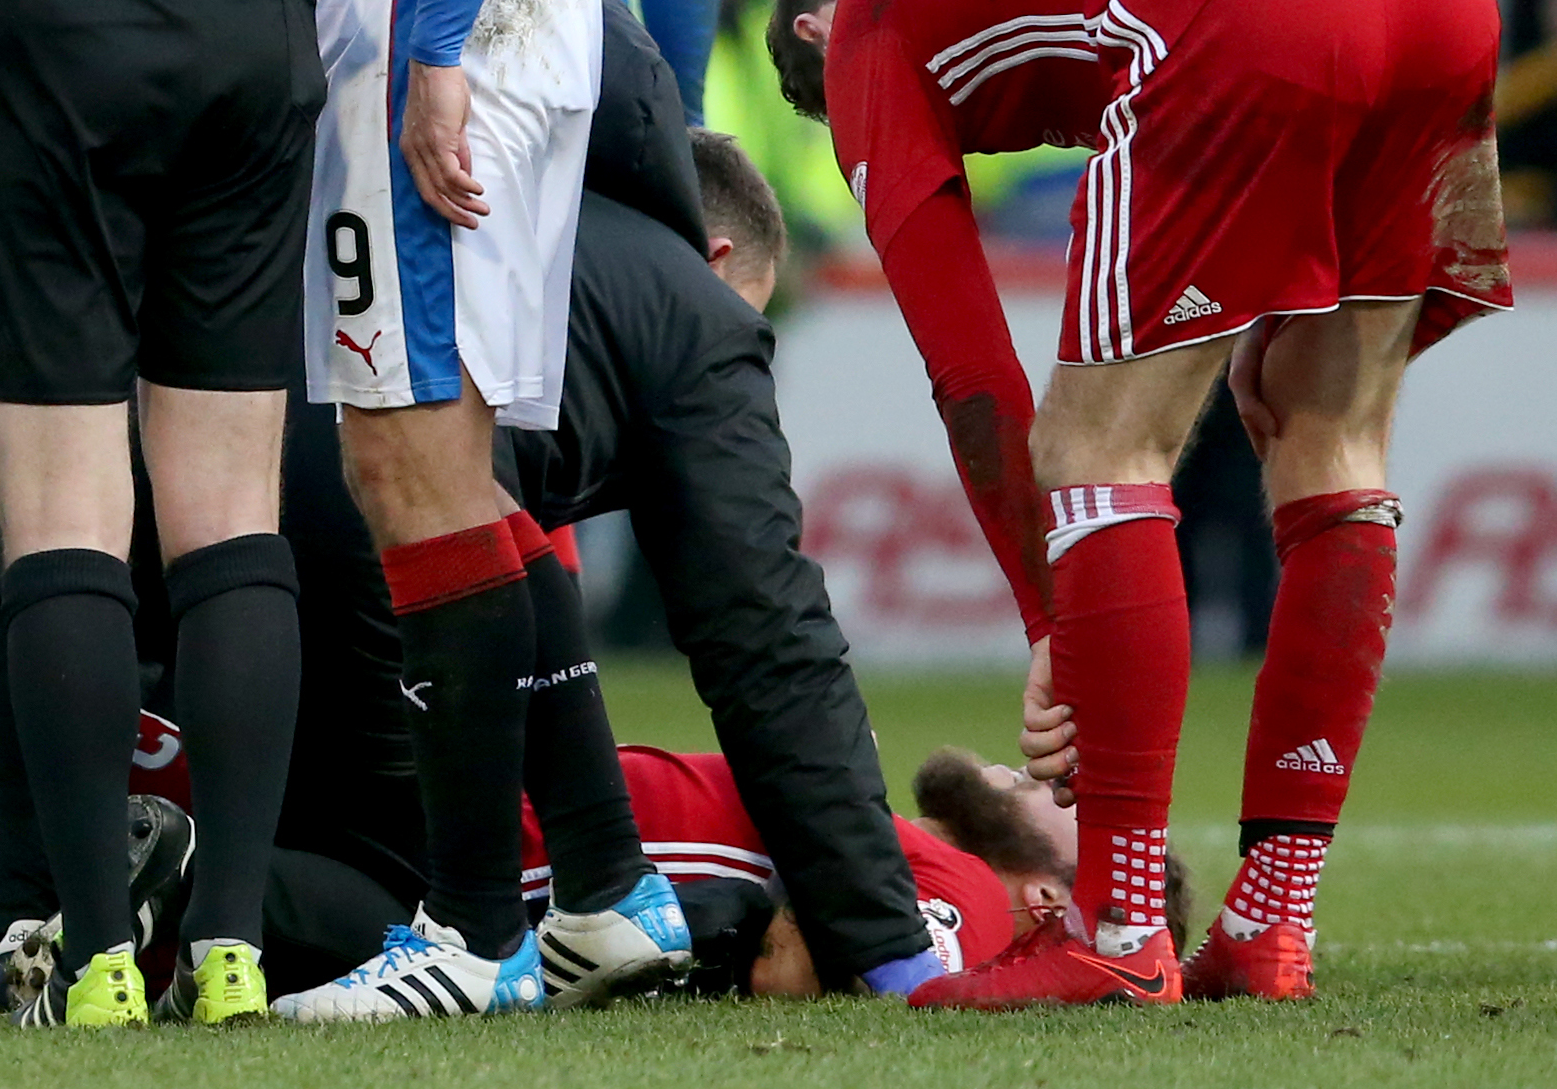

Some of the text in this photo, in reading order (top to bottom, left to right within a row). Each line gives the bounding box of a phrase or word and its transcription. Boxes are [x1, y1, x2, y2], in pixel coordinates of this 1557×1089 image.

[325, 208, 375, 317] 9
[1163, 301, 1223, 325] adidas
[1275, 758, 1345, 775] adidas
